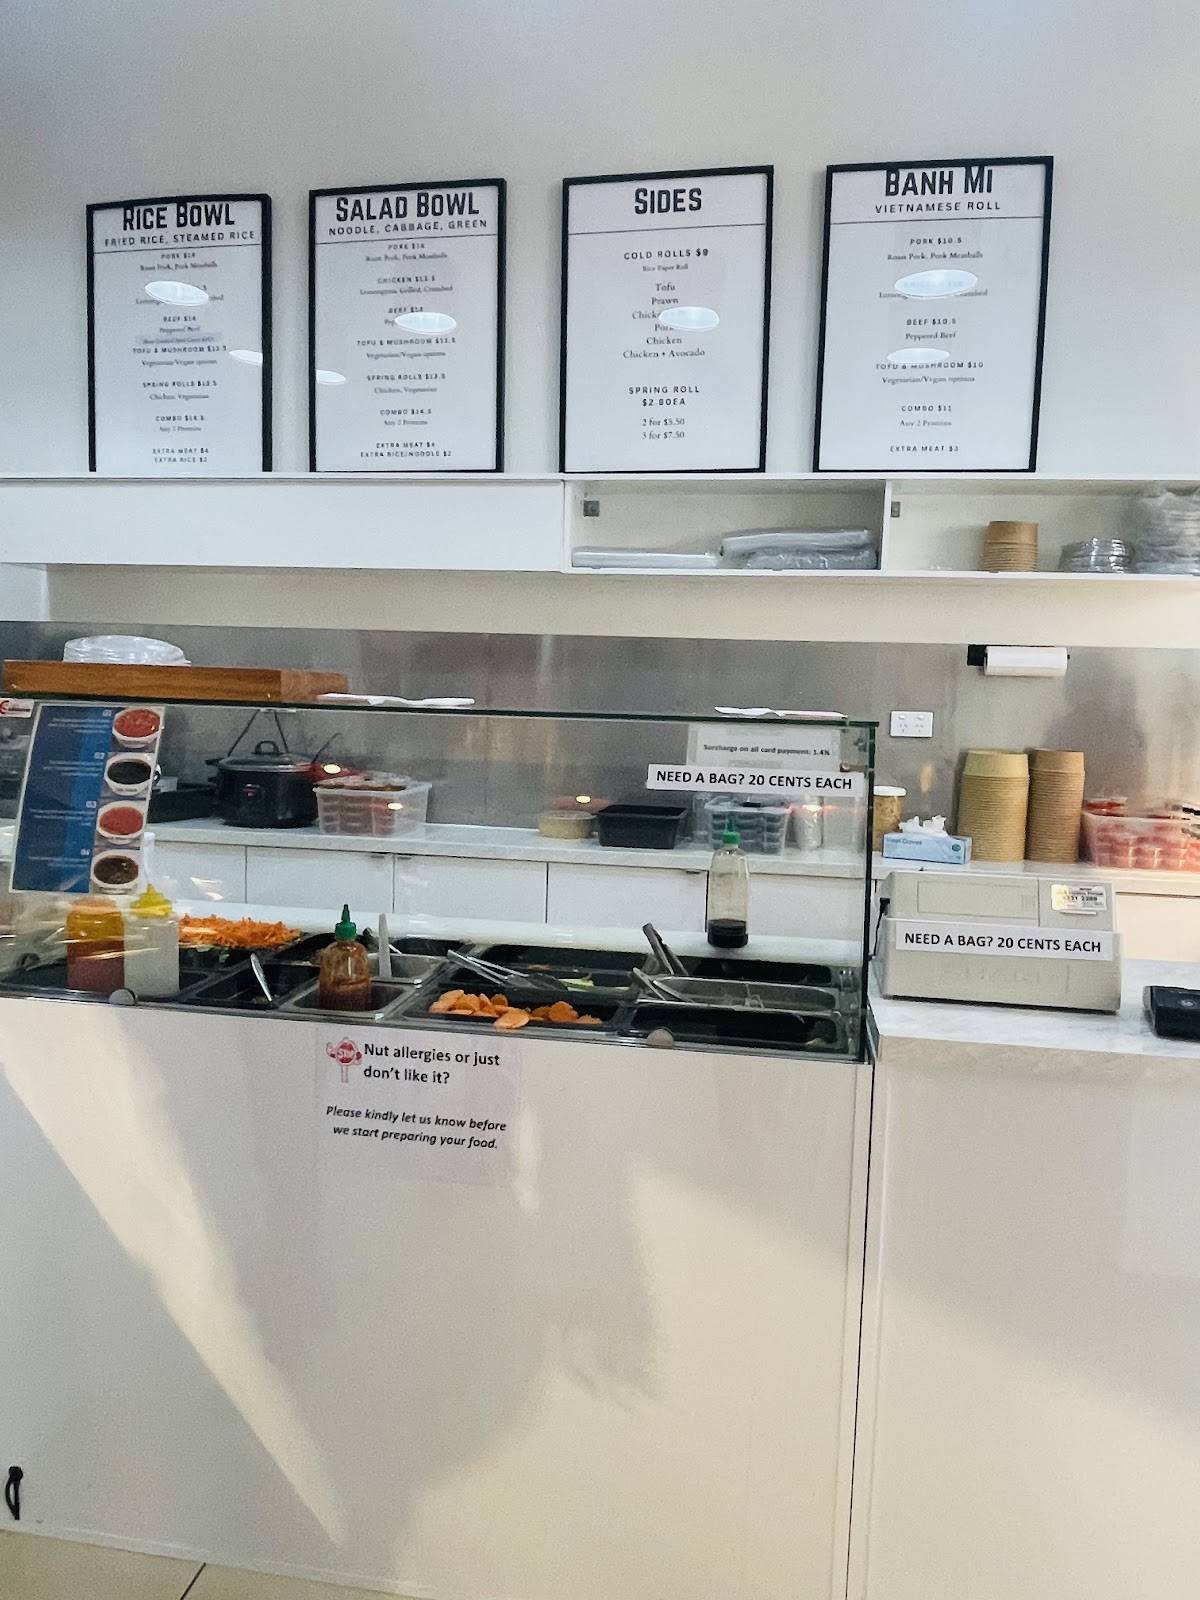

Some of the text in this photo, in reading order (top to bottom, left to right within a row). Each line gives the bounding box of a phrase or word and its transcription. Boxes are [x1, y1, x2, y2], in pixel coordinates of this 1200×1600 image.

[885, 166, 993, 196] BANH MI
[336, 192, 480, 222] SALAD BOWL
[634, 187, 702, 214] SIDES
[875, 201, 1000, 214] VIETNAMESE ROLL
[123, 203, 235, 231] RICE BOWL
[328, 220, 487, 236] NOODLE, CABBAGE, GREEN
[105, 231, 255, 247] FRIED RICE, STEAMED RICE
[623, 251, 653, 260] COLD
[657, 249, 691, 258] ROLLS
[655, 281, 676, 291] Tofu
[651, 297, 679, 305] Prawn
[906, 318, 928, 326] BEEF
[646, 337, 682, 345] Chicken
[622, 347, 706, 359] Chicken Avocado
[628, 385, 700, 395] SPRING ROLL
[649, 417, 661, 426] for
[663, 418, 685, 426] $5.50
[649, 430, 661, 439] for
[663, 431, 685, 439] $7.50
[703, 744, 738, 752] Surcharge
[656, 770, 852, 790] NEED A BAG? 20 CENTS EACH
[904, 932, 1102, 953] NEED A BAG? 20 CENTS EACH
[363, 1043, 500, 1067] Nut allergies or just
[363, 1065, 450, 1084] don’t like it?
[326, 1105, 507, 1132] Please kindly let us know before
[333, 1126, 498, 1149] we start preparing your food.
